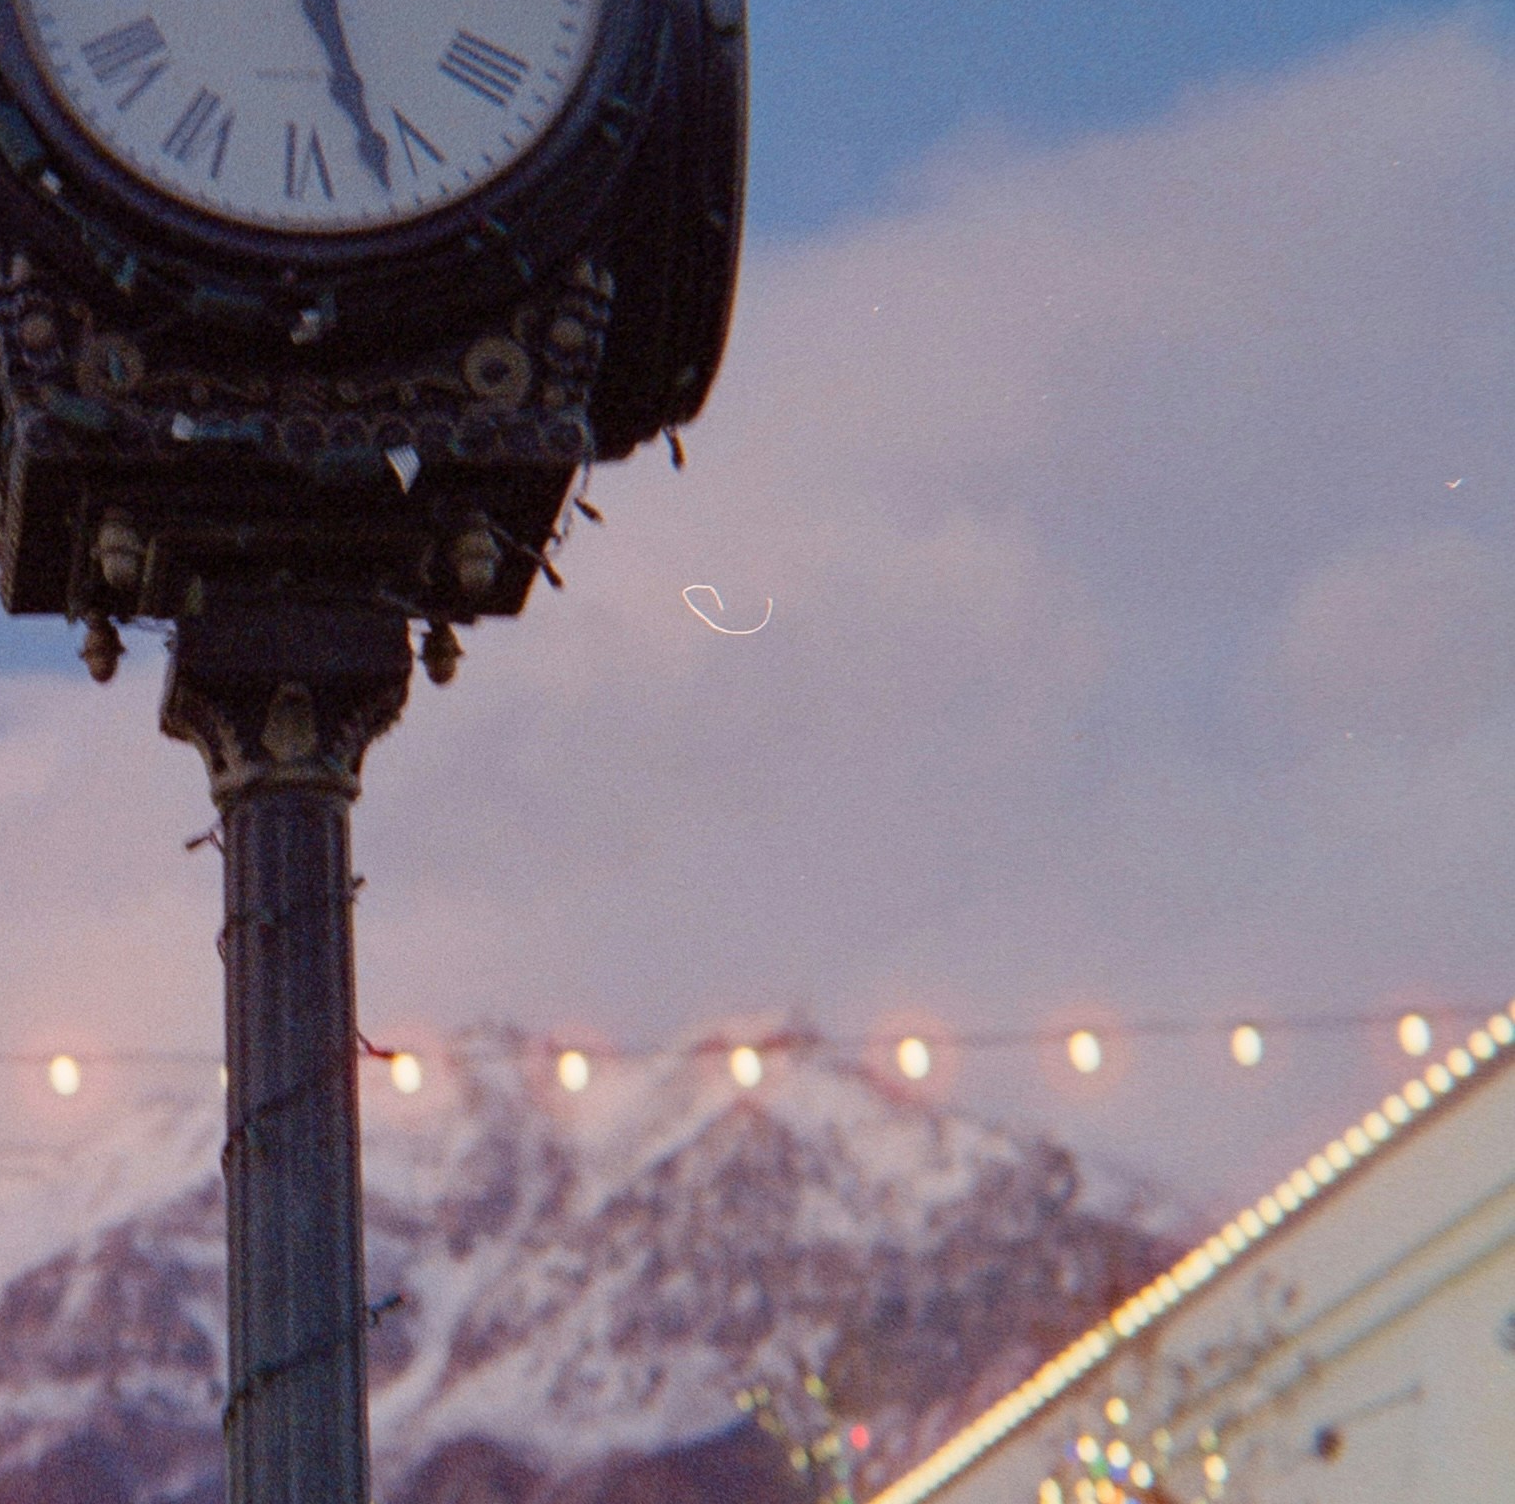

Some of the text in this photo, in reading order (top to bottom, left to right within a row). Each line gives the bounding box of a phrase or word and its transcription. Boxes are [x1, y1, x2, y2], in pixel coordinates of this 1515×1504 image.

[80, 15, 169, 112] VIII
[438, 29, 531, 107] IIII
[162, 87, 237, 180] VII
[285, 121, 334, 200] VI
[390, 106, 446, 178] V
